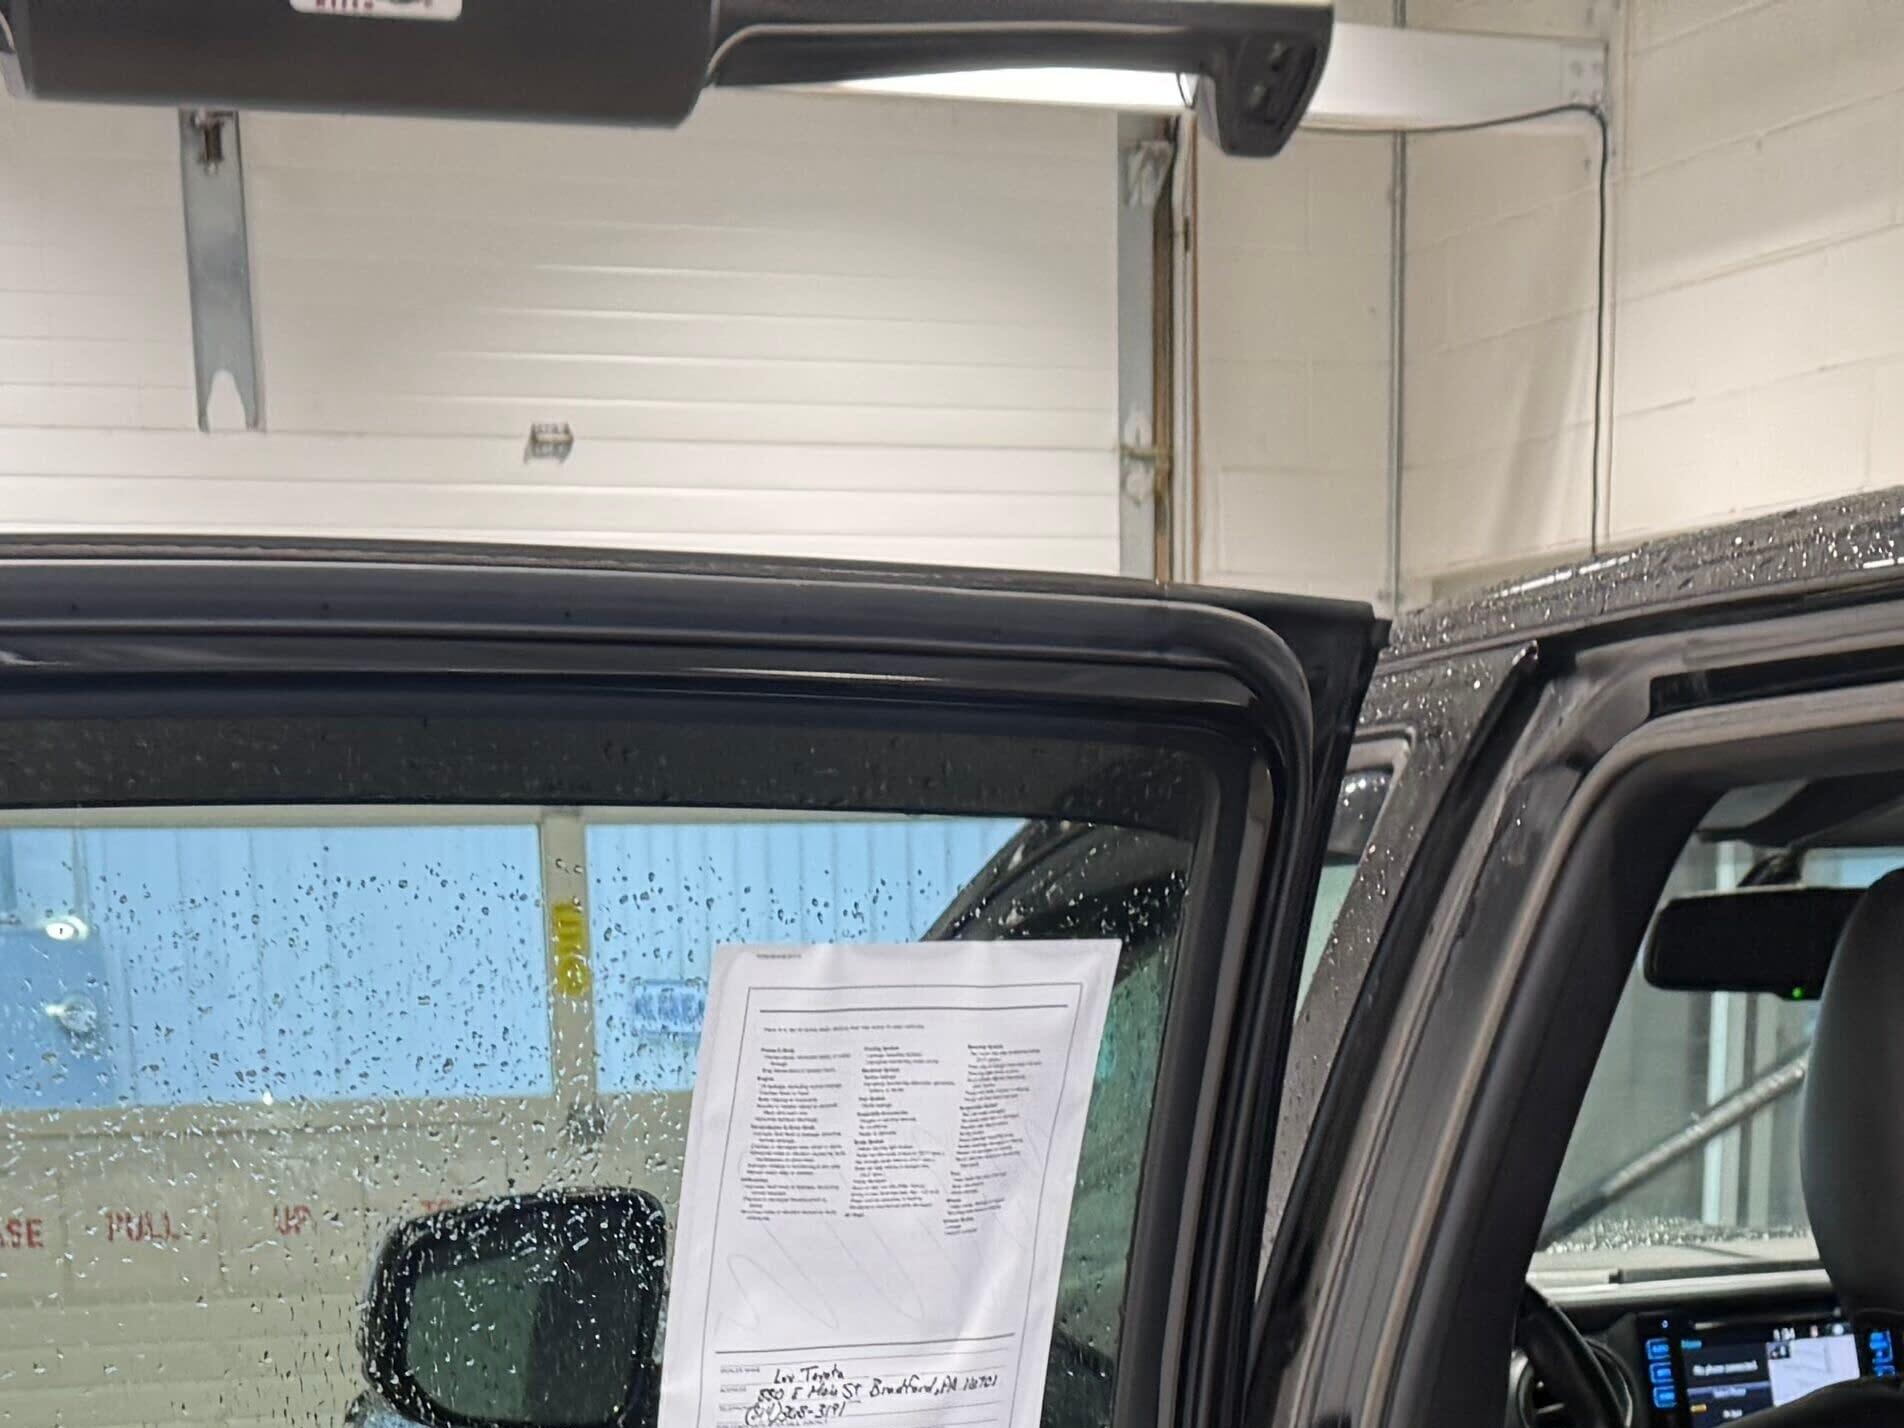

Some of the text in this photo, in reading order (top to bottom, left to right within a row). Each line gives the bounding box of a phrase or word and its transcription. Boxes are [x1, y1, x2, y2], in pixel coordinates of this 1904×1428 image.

[105, 1209, 182, 1242] PULL
[273, 1204, 313, 1236] UP
[800, 1363, 845, 1383] Toyota
